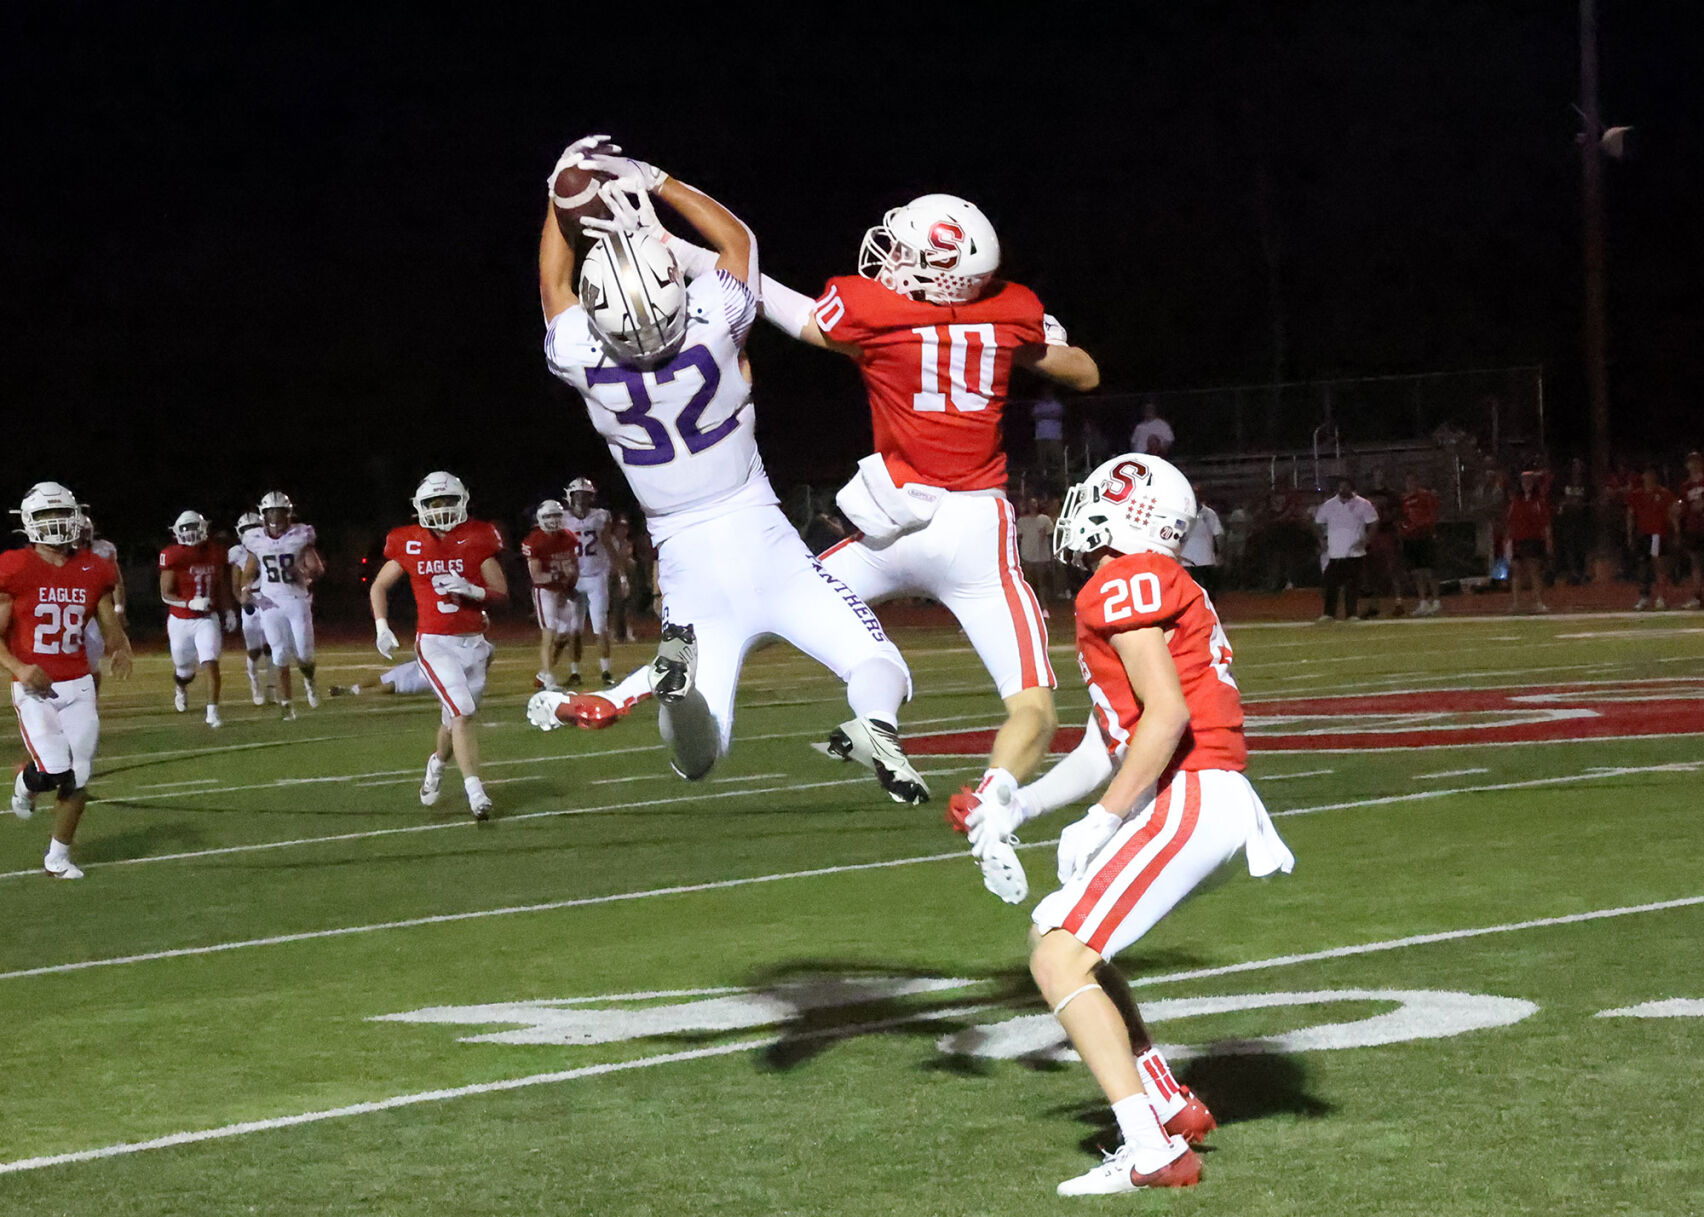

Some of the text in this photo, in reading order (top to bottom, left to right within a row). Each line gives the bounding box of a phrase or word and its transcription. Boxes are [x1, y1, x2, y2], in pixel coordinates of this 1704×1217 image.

[924, 219, 966, 272] S
[814, 285, 846, 332] 10
[911, 322, 997, 412] 10
[584, 343, 743, 468] 32
[1100, 459, 1150, 506] S
[406, 541, 421, 555] C
[417, 559, 465, 575] EAGLES
[38, 587, 87, 604] EAGLES
[1100, 572, 1162, 623] 20
[33, 604, 87, 655] 28
